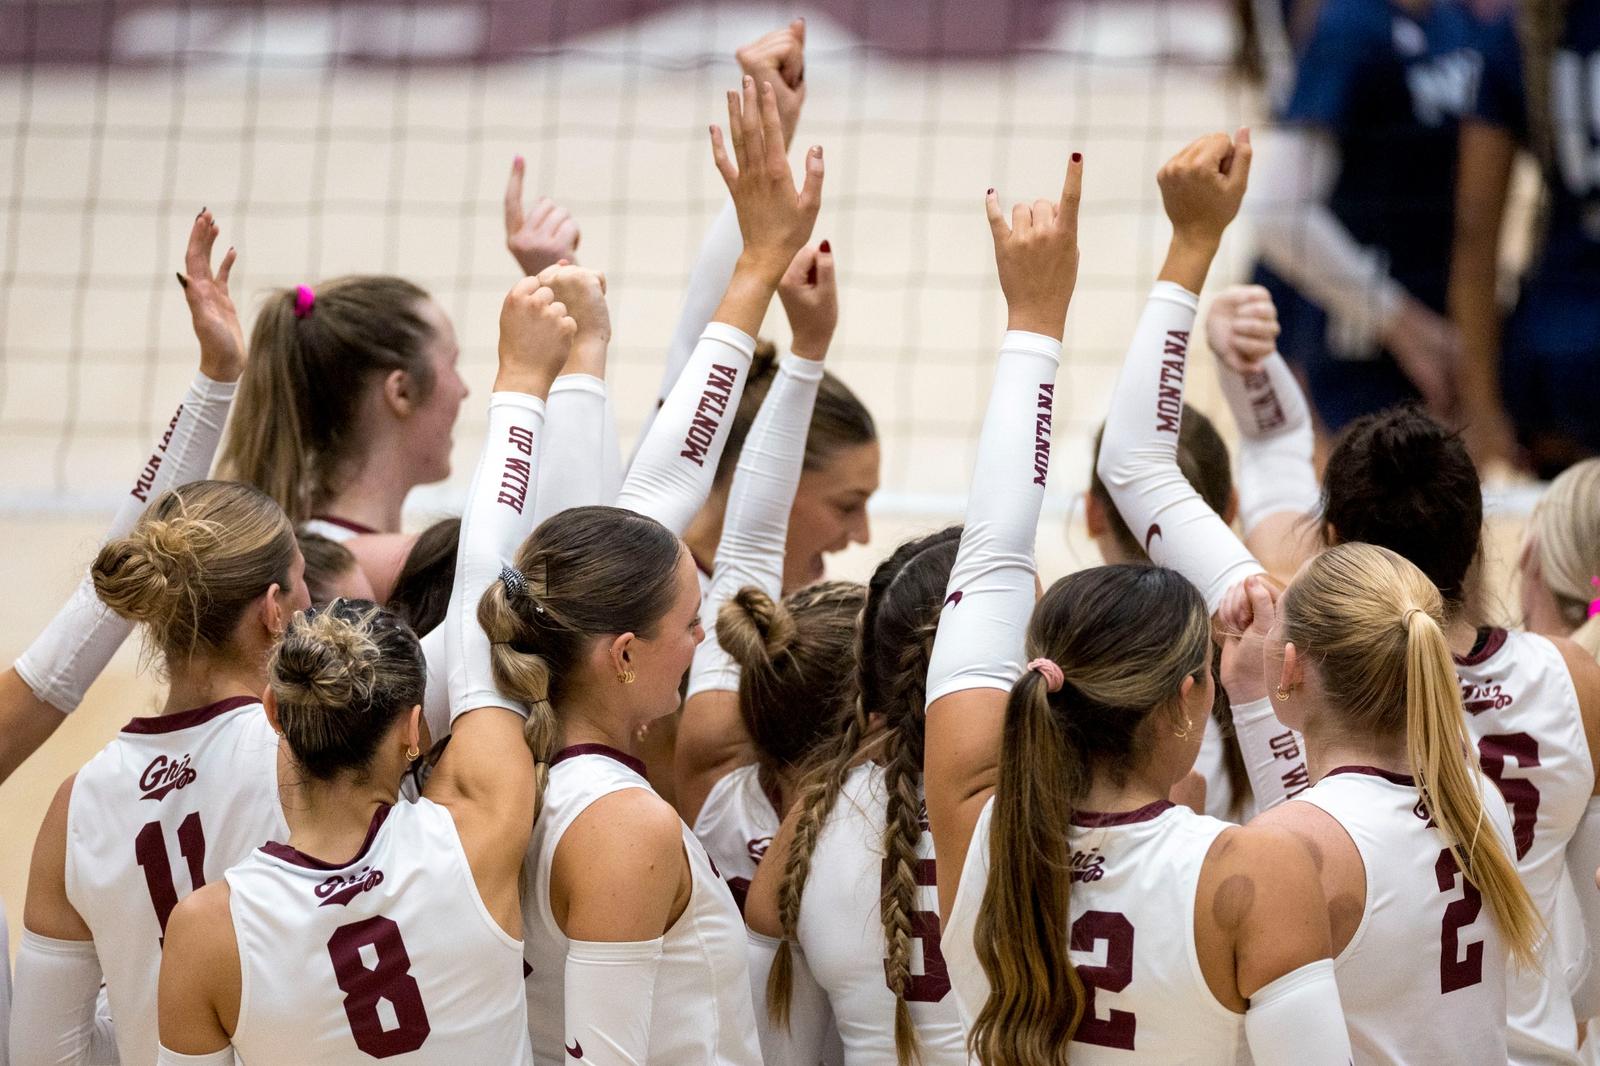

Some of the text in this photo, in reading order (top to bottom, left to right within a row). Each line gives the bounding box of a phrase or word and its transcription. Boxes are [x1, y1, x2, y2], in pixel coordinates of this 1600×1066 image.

[680, 363, 738, 468] MONTANA
[1156, 330, 1190, 435] MONTANA
[497, 425, 534, 515] UP WITH
[1033, 383, 1055, 489] MONTANA
[139, 753, 198, 792] Griz
[1269, 730, 1300, 760] UP
[134, 811, 207, 951] 11
[1069, 847, 1106, 883] riz
[1434, 842, 1484, 995] 2
[327, 914, 431, 1060] 8
[1070, 910, 1137, 1051] 2
